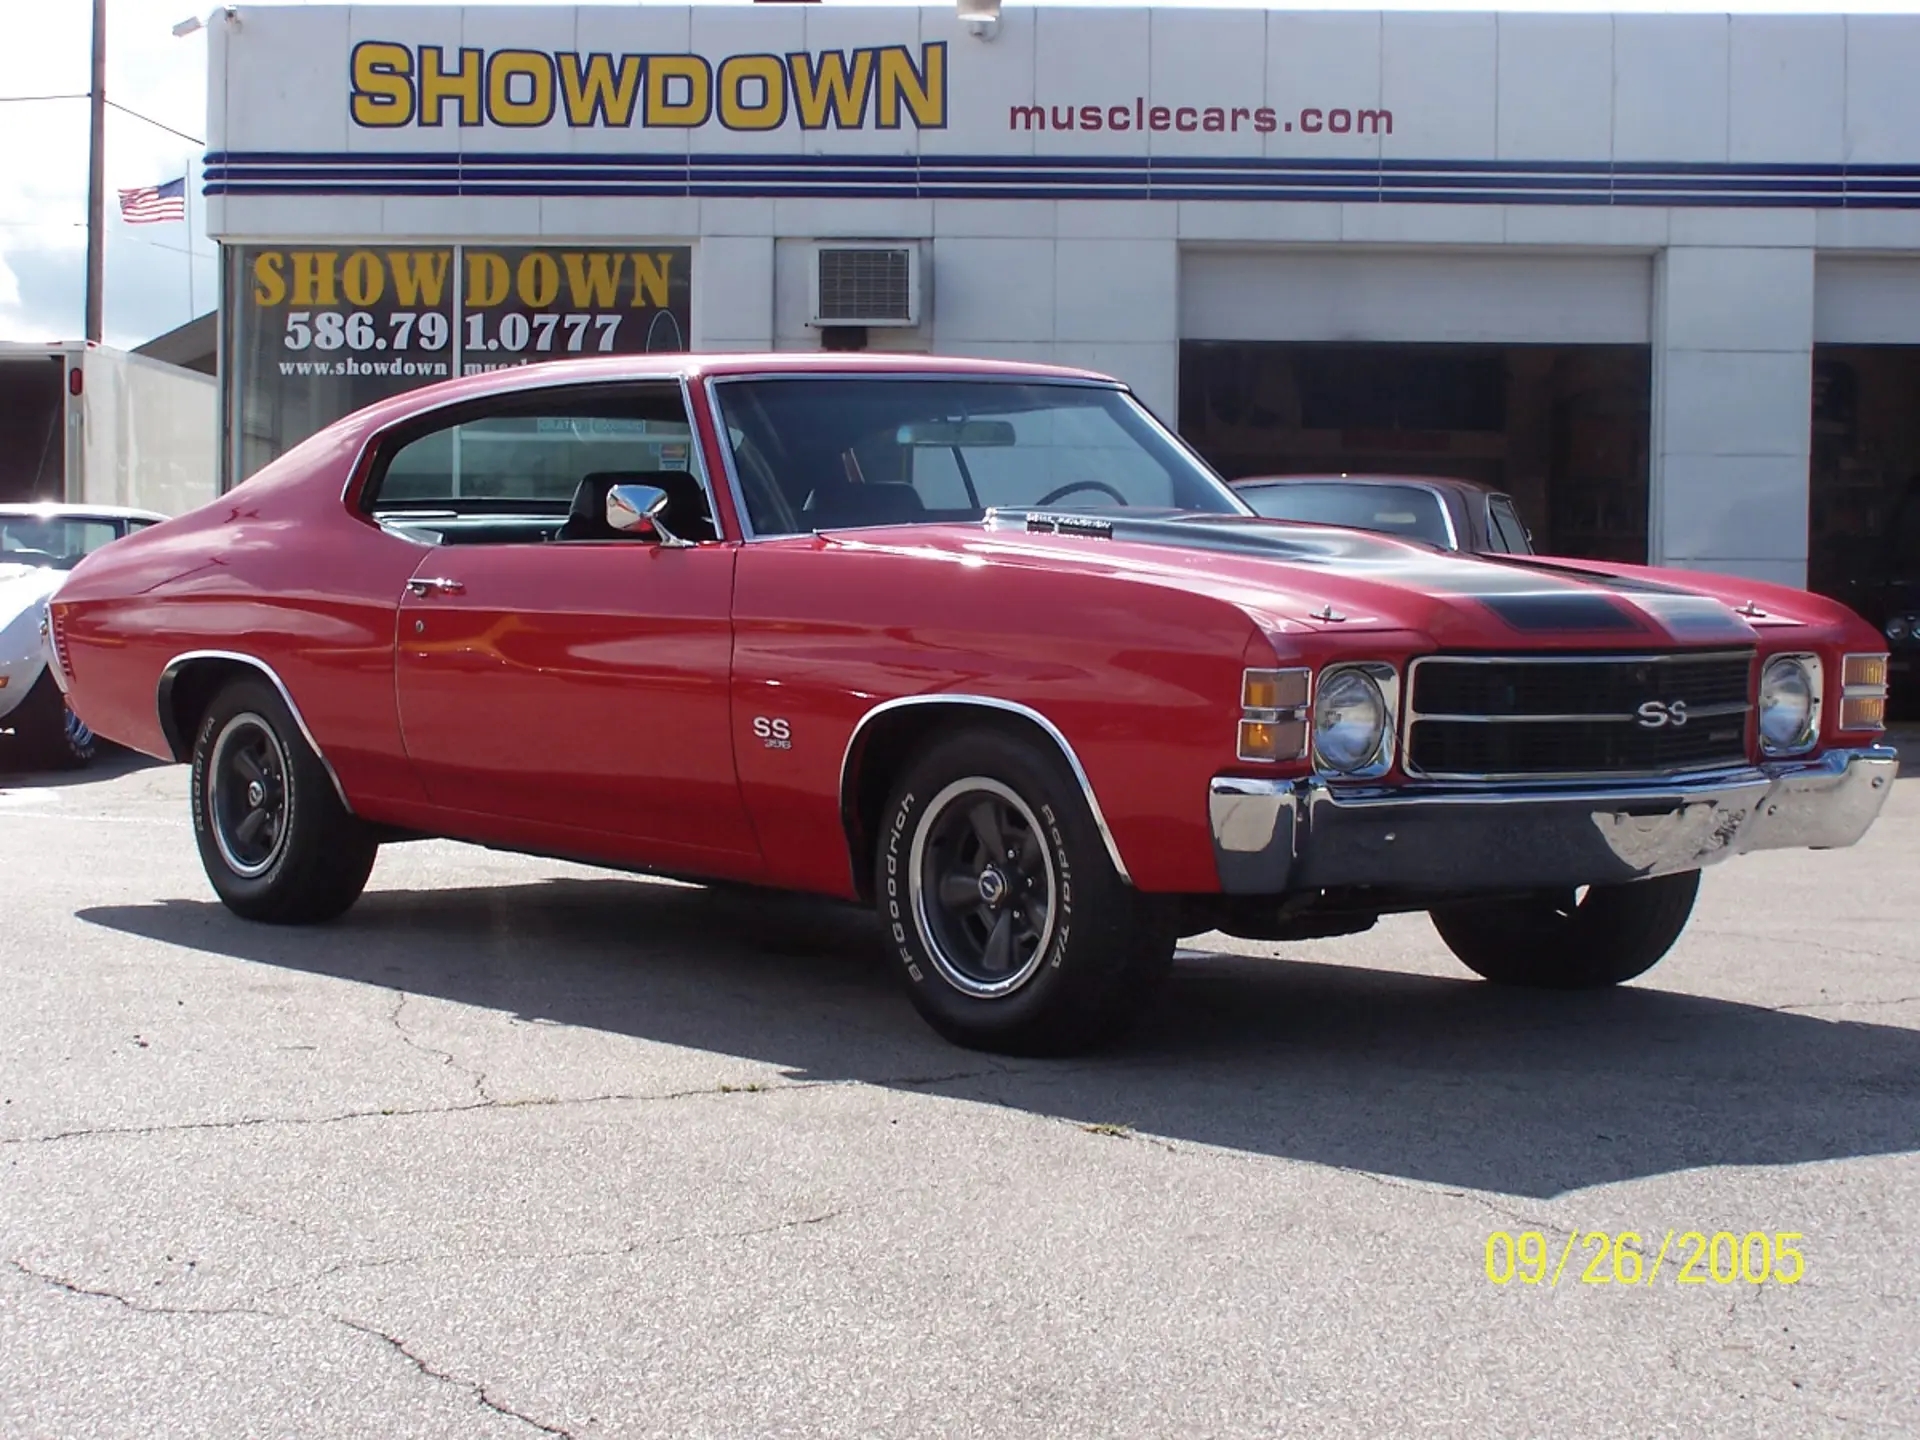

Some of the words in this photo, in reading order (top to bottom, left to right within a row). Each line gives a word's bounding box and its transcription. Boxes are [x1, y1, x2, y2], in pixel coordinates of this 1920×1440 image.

[349, 40, 948, 130] SHOWDOWN
[1009, 96, 1394, 134] musclecars.com
[753, 716, 790, 739] SS
[1638, 700, 1687, 727] SS
